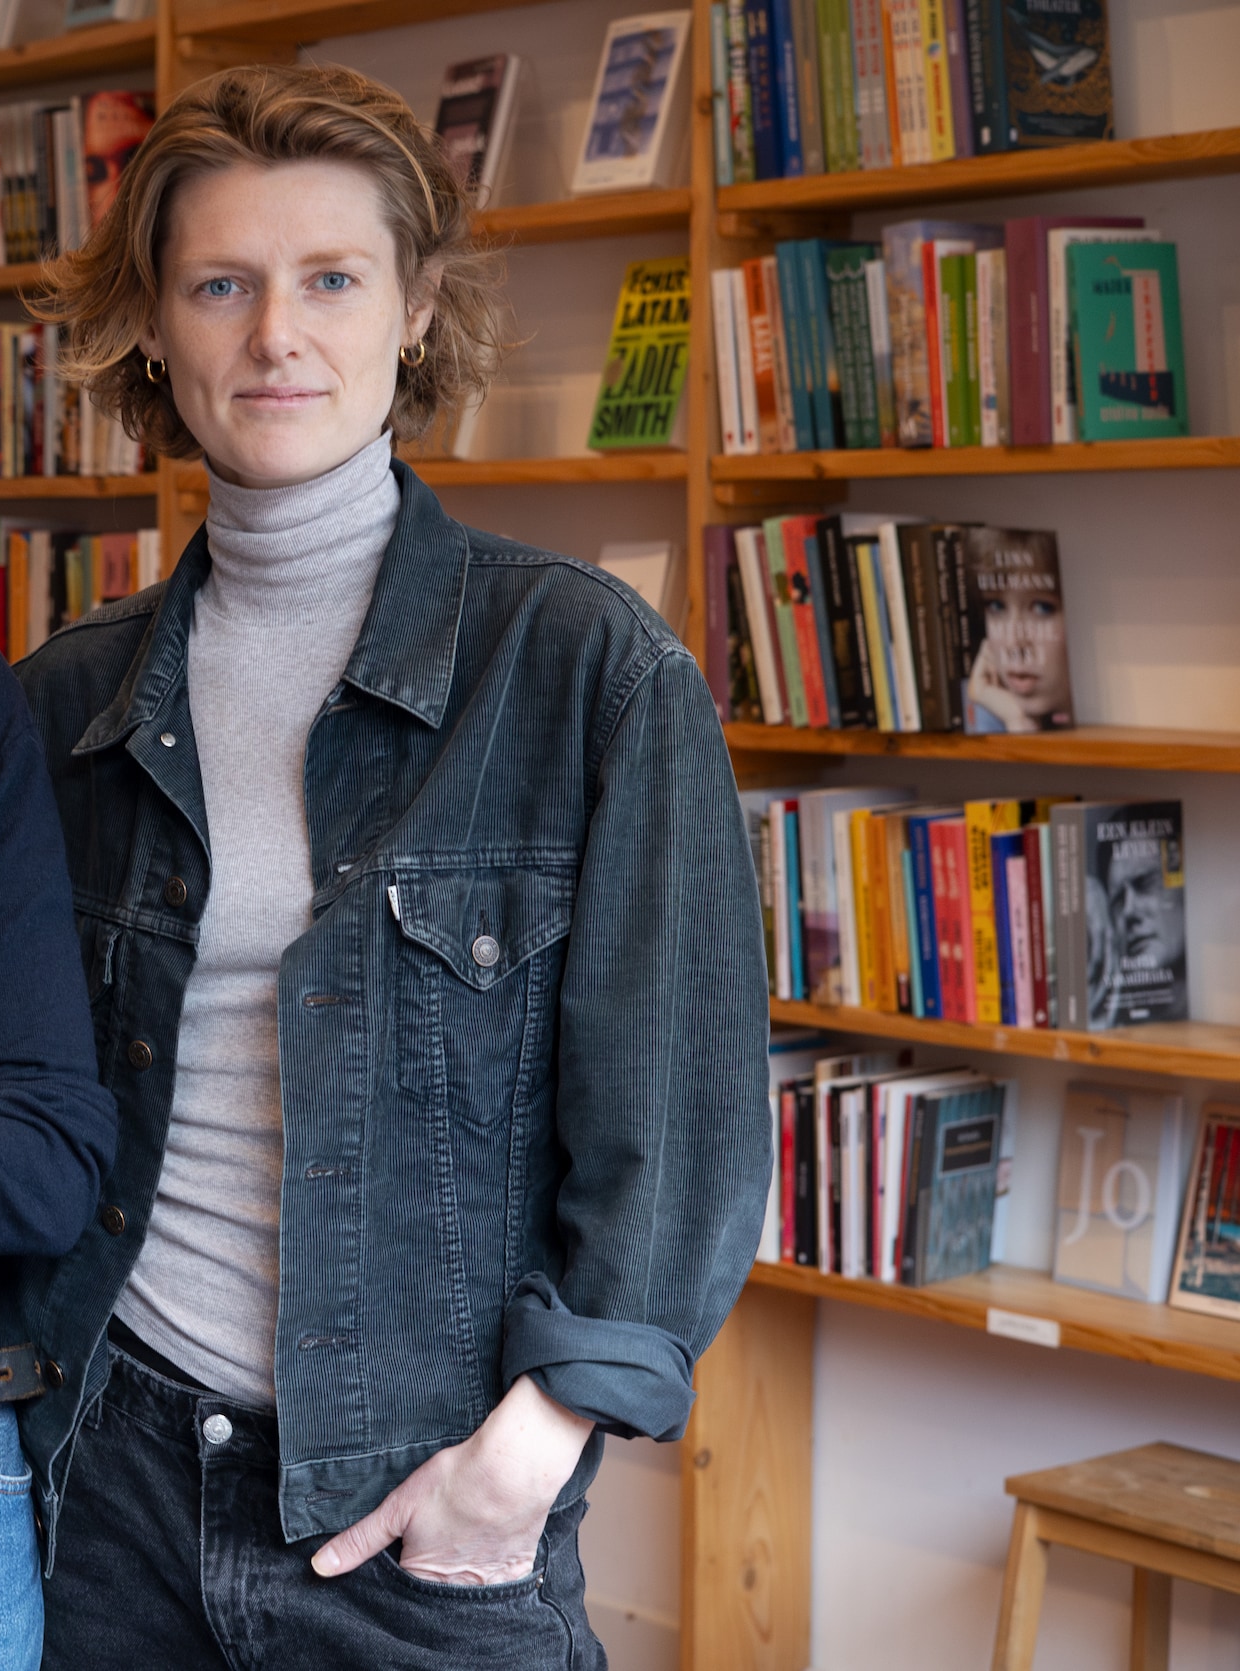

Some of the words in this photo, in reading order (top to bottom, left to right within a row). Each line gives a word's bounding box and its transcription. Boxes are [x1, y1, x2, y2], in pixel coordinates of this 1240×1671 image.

[604, 342, 687, 399] ZADIE
[596, 401, 673, 439] SMITH
[1097, 822, 1128, 841] EEN
[1129, 818, 1174, 837] KLEIN
[1063, 1126, 1152, 1246] Jo
